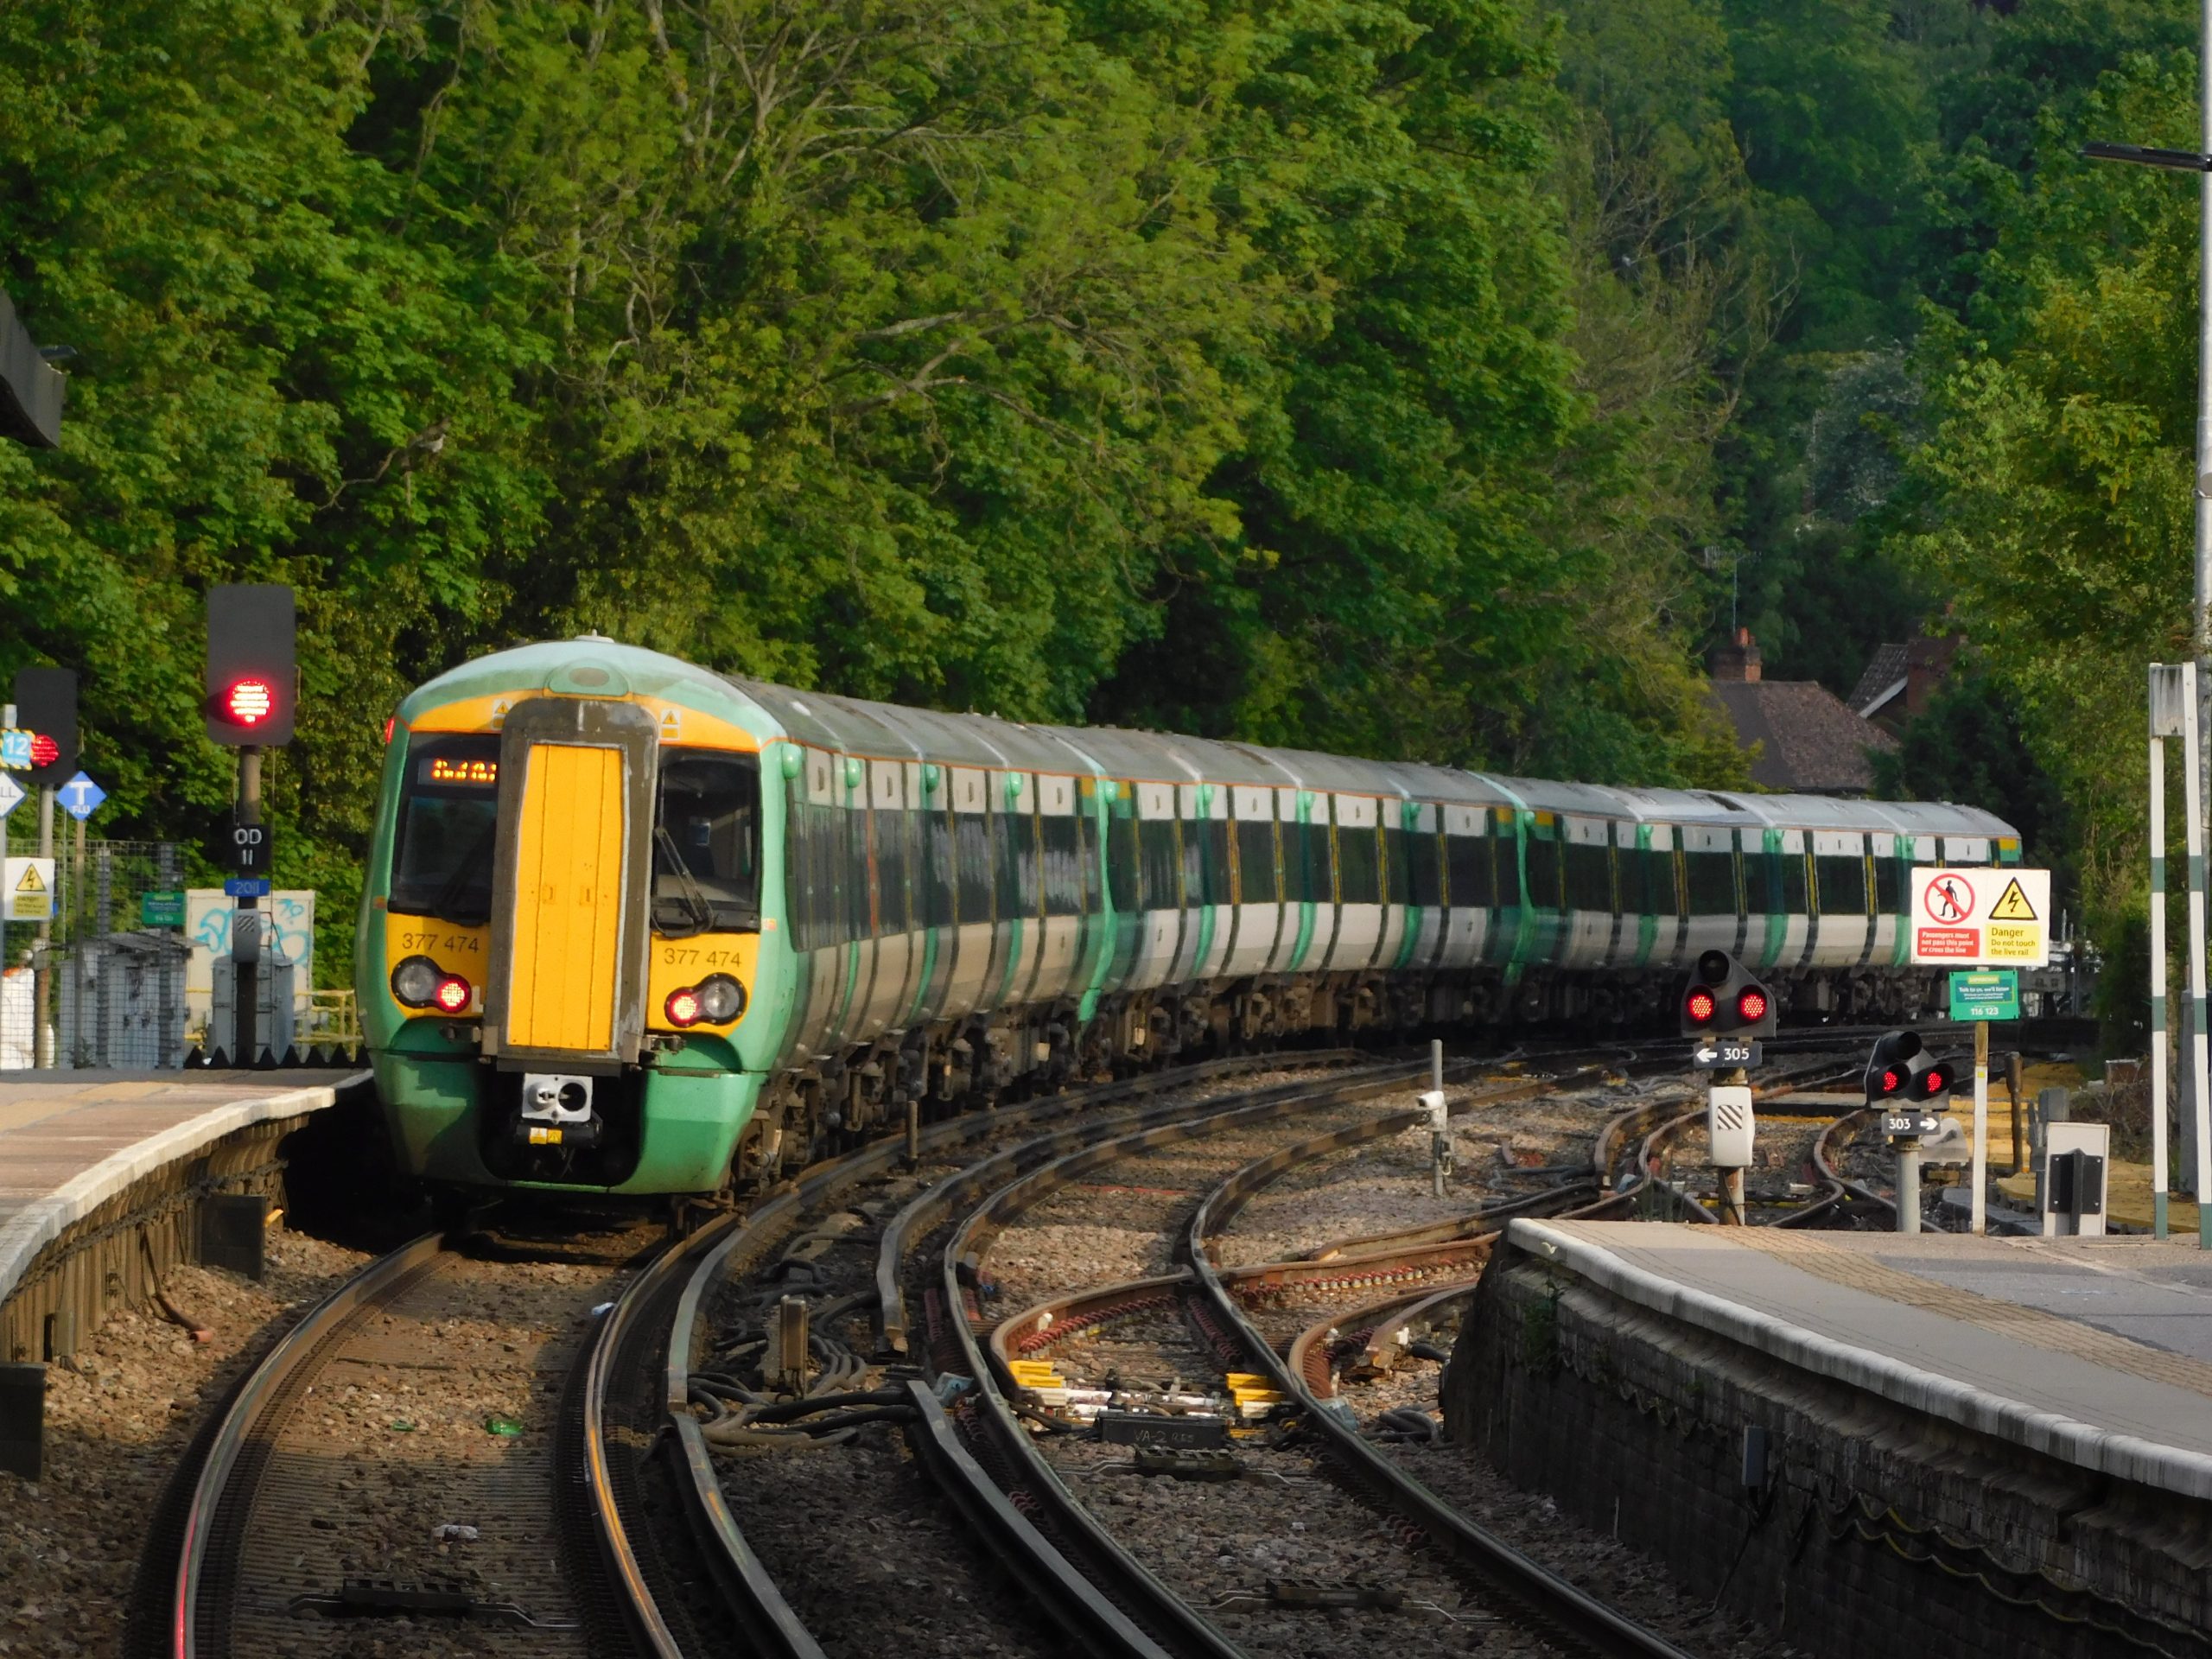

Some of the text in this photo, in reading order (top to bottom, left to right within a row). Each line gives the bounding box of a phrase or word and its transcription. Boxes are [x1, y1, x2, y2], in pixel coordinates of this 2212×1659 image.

[6, 734, 29, 755] 12
[69, 781, 93, 805] T
[234, 829, 262, 844] OD
[235, 881, 260, 894] 2011
[1991, 927, 2024, 938] Danger
[402, 932, 479, 953] 377 474
[664, 947, 742, 968] 377 474
[1985, 1007, 1999, 1015] 123
[1724, 1047, 1750, 1061] 305
[1888, 1118, 1911, 1130] 303
